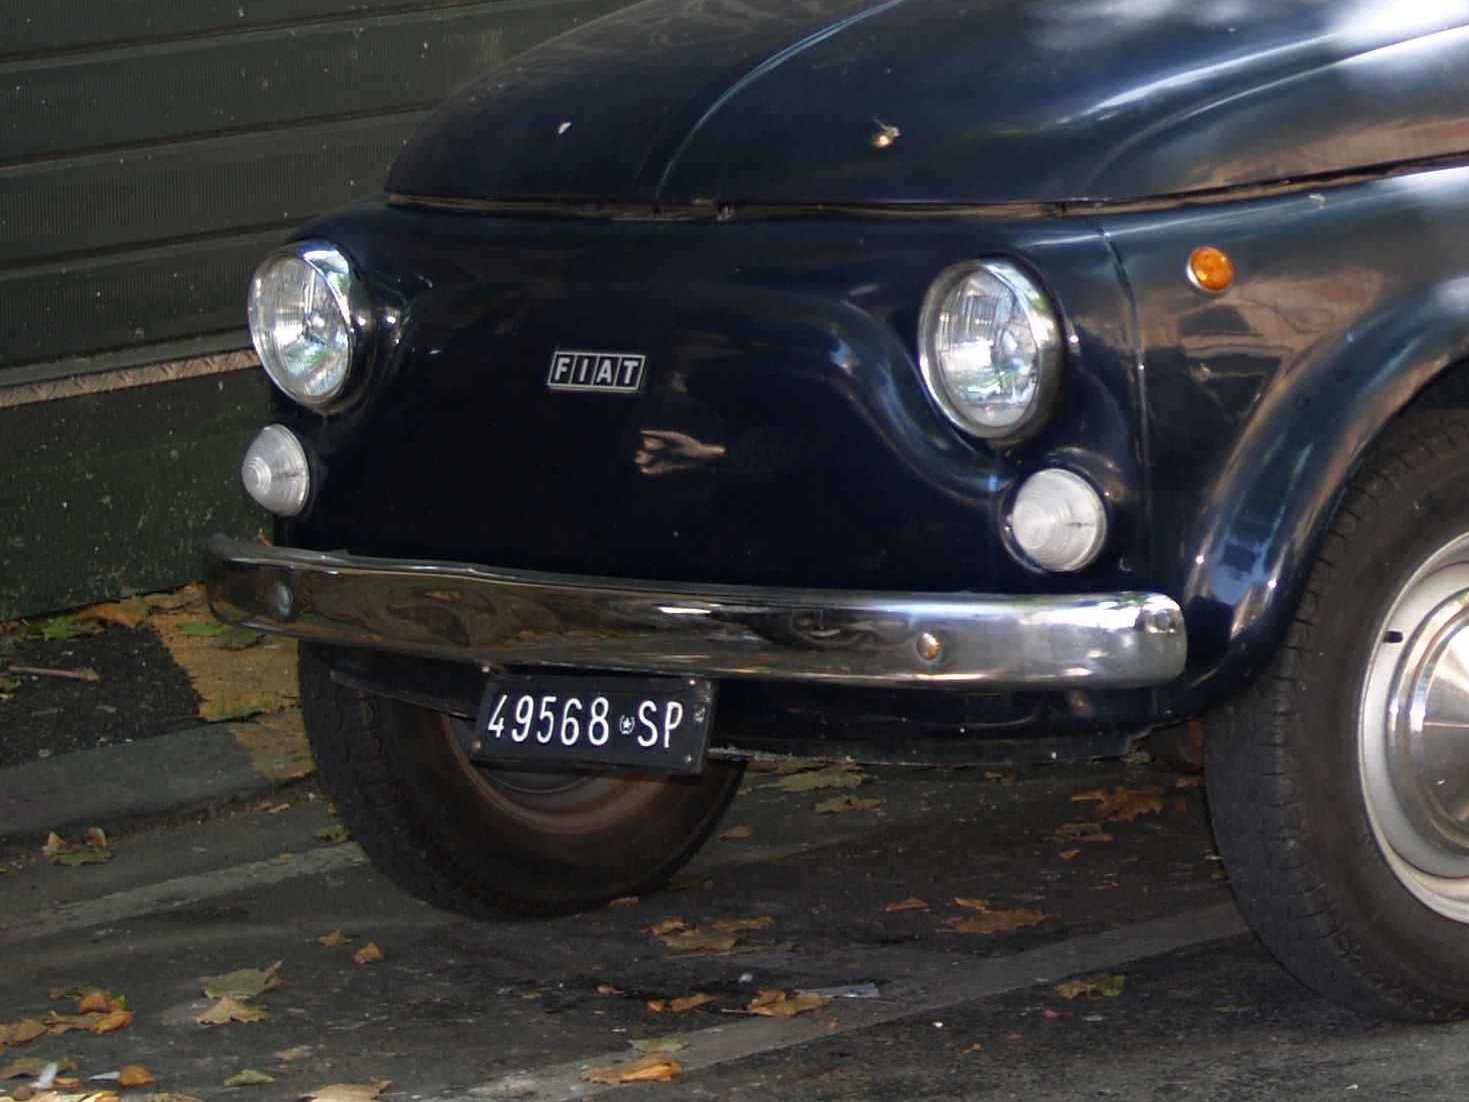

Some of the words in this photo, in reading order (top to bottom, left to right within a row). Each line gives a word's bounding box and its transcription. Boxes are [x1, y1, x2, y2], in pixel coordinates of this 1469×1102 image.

[553, 356, 639, 385] FIAT
[488, 694, 609, 746] 49568
[637, 700, 683, 748] SP
